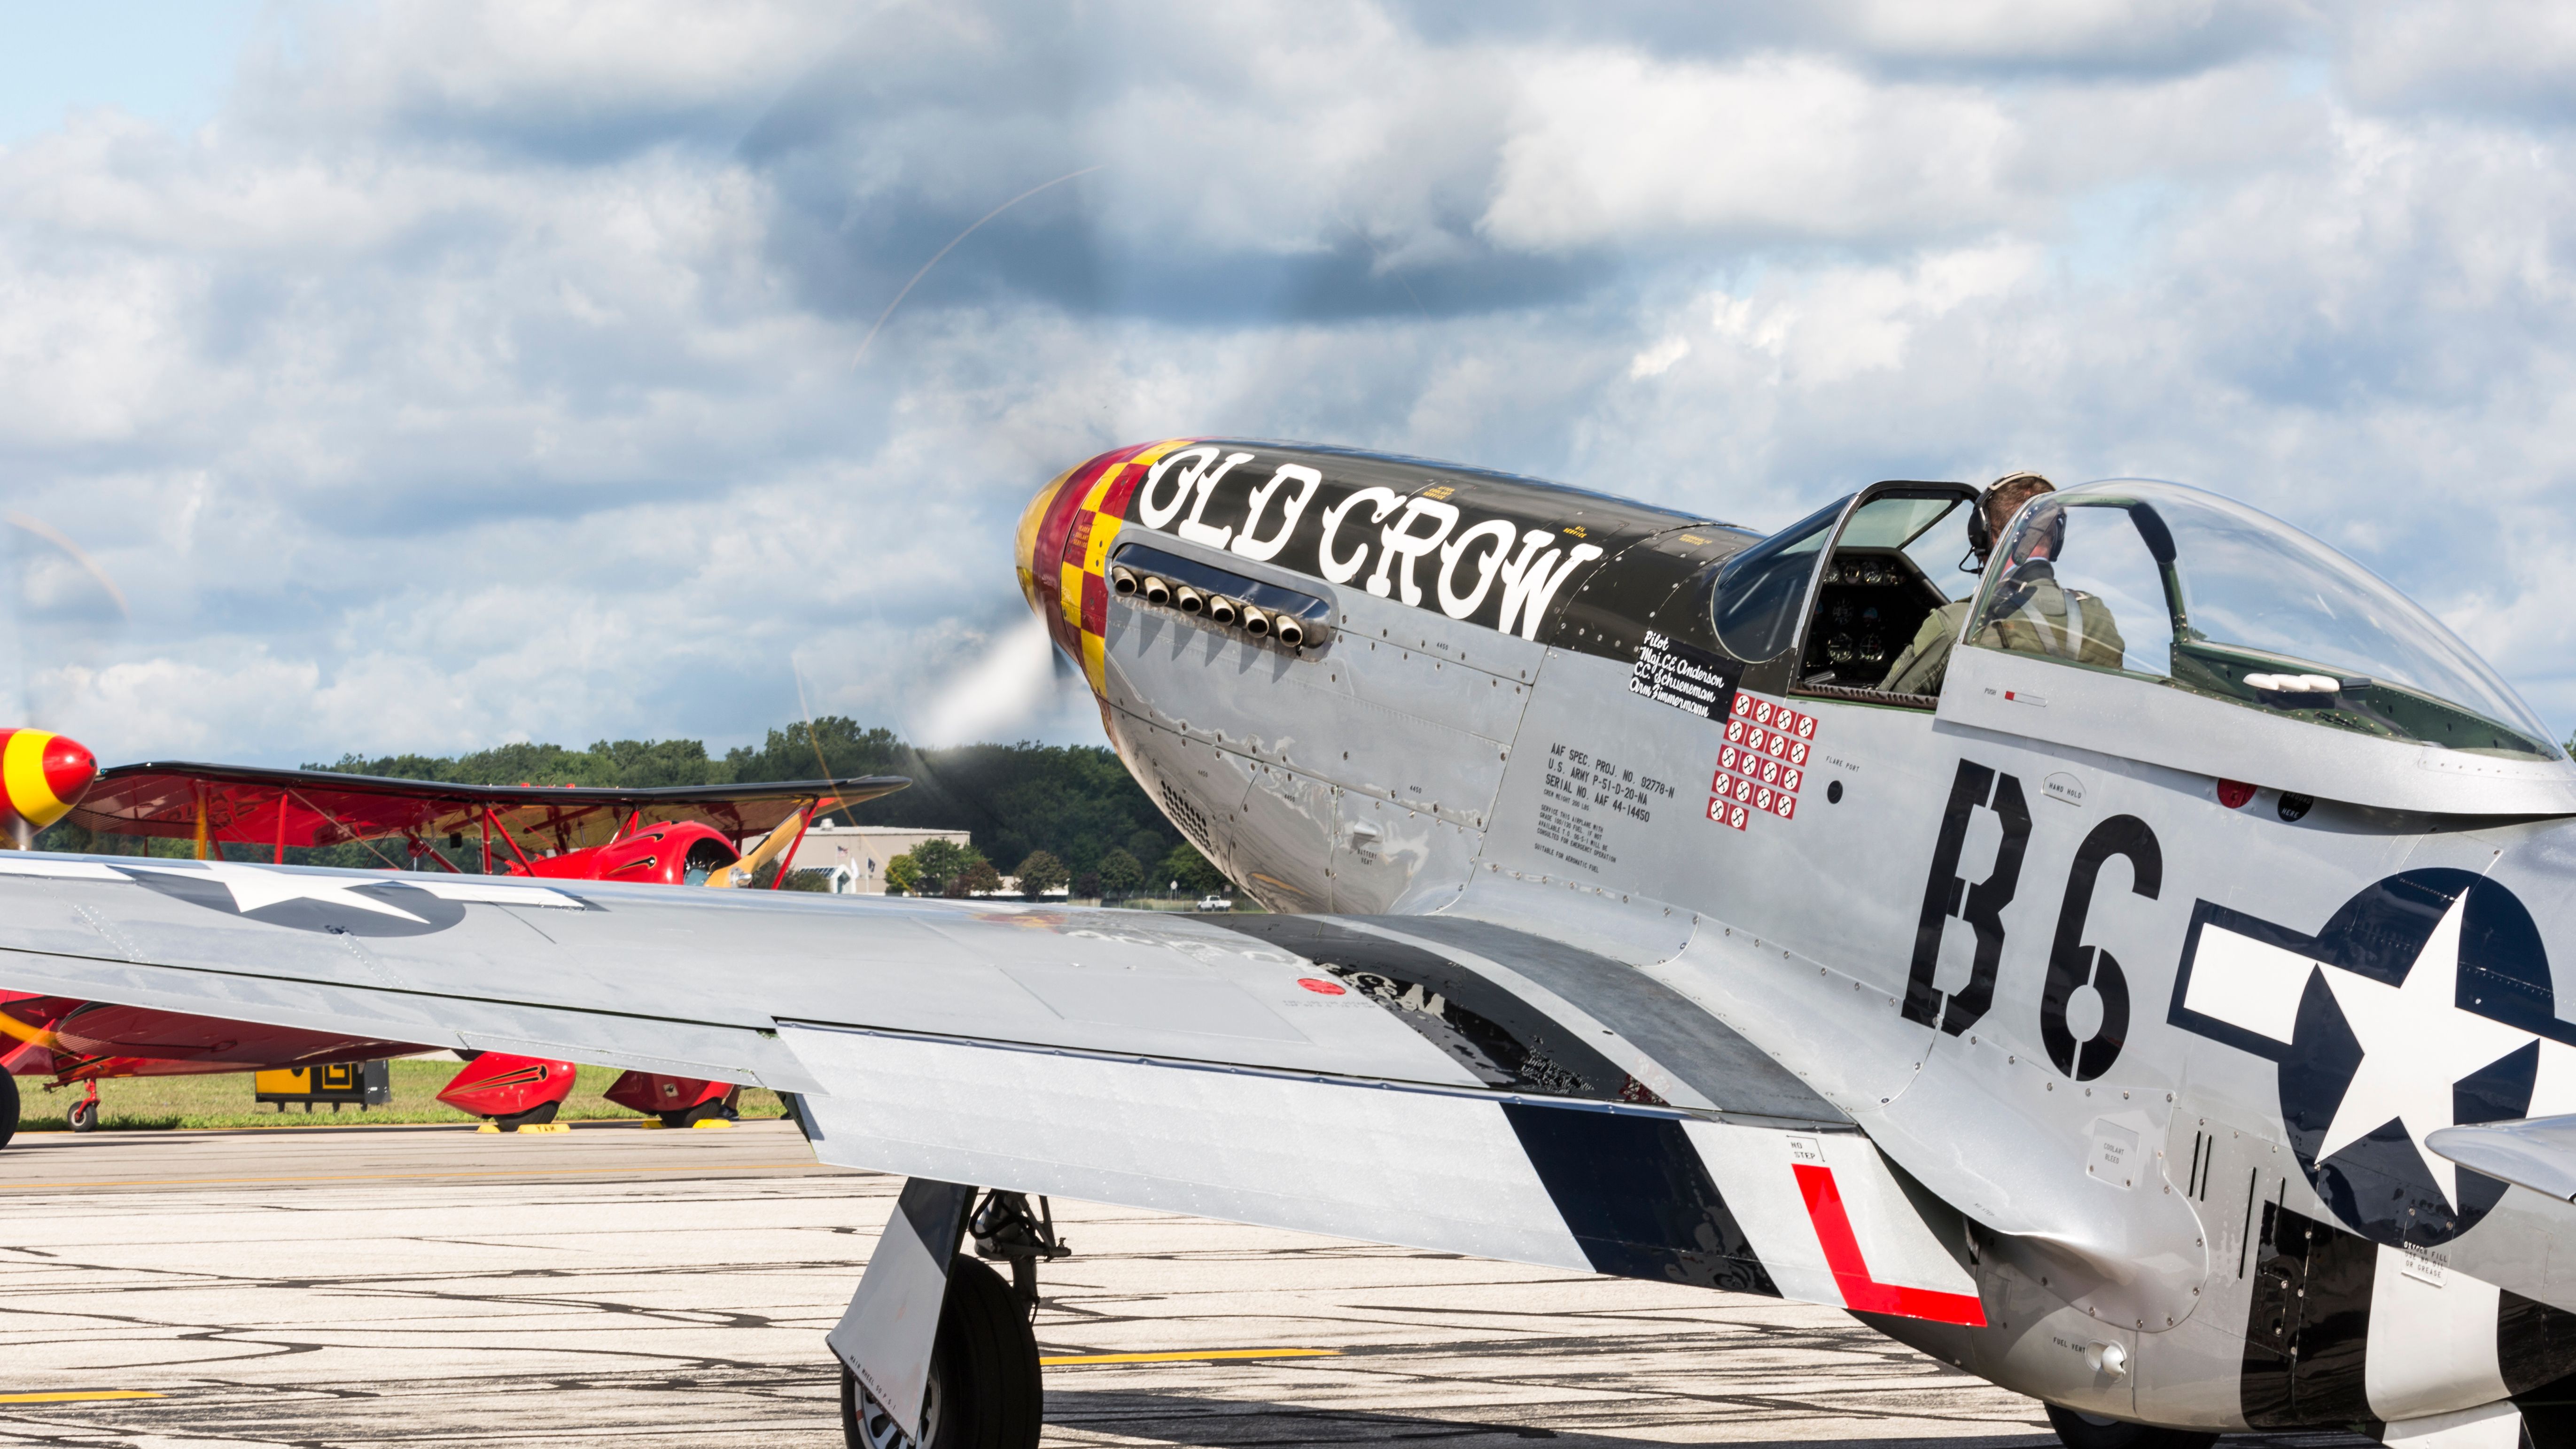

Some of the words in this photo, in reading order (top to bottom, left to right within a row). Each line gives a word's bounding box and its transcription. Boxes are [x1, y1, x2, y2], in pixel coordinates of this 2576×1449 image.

[1563, 528, 1587, 538] SERVICE
[1139, 447, 1322, 561] OLD
[1319, 487, 1603, 641] CROW
[1437, 642, 1448, 651] 4450
[1643, 630, 1669, 651] Pilot
[1677, 659, 1724, 688] Anderson
[1654, 669, 1716, 702] Schueneman
[1651, 684, 1709, 717] Zimmermann
[1198, 769, 1208, 778] 4450
[1551, 743, 1566, 756] AAF
[1641, 776, 1675, 798] 92778-N
[1826, 755, 1843, 767] FLARE
[1845, 762, 1860, 773] PORT
[1409, 785, 1422, 794] 4450
[1549, 758, 1565, 774] U.S.
[1571, 767, 1590, 783] ARMY
[1593, 775, 1647, 806] P-51-D-20-NA
[2049, 782, 2064, 793] HAND
[2067, 788, 2082, 799] HOLD
[1544, 789, 1554, 797] CREW
[1556, 793, 1571, 804] WEIGHT
[1546, 774, 1572, 794] SERIAL
[1595, 792, 1609, 806] AAF
[1612, 799, 1650, 822] 44-14450
[1540, 812, 1552, 821] GRADE
[1541, 804, 1558, 816] SERVICE
[1560, 812, 1570, 820] THIS
[1572, 816, 1592, 829] AIRPLANE
[1593, 824, 1603, 833] WITH
[2281, 807, 2299, 818] HERE
[1538, 820, 1561, 833] AVAILABLE
[1590, 840, 1600, 849] WILL
[1357, 848, 1377, 860] BATTERY
[1537, 828, 1559, 841] CONSULTED
[1570, 840, 1592, 853] EMERGENCY
[1594, 849, 1617, 863] OPERATION
[1361, 857, 1372, 866] VENT
[1534, 843, 1555, 856] SUITABLE
[1588, 864, 1599, 873] FUEL
[2104, 1143, 2124, 1155] COOLANT
[2105, 1154, 2119, 1164] BLEED
[2404, 1241, 2428, 1255] OXYGEN
[2431, 1251, 2447, 1263] FILL
[2405, 1250, 2416, 1260] USE
[2421, 1256, 2428, 1264] NO
[2433, 1261, 2444, 1270] OIL
[2418, 1264, 2442, 1278] GREASE
[2054, 1337, 2068, 1348] FUEL
[2071, 1343, 2086, 1354] VENT
[849, 1355, 861, 1369] MAIN
[861, 1368, 874, 1386] WHEEL
